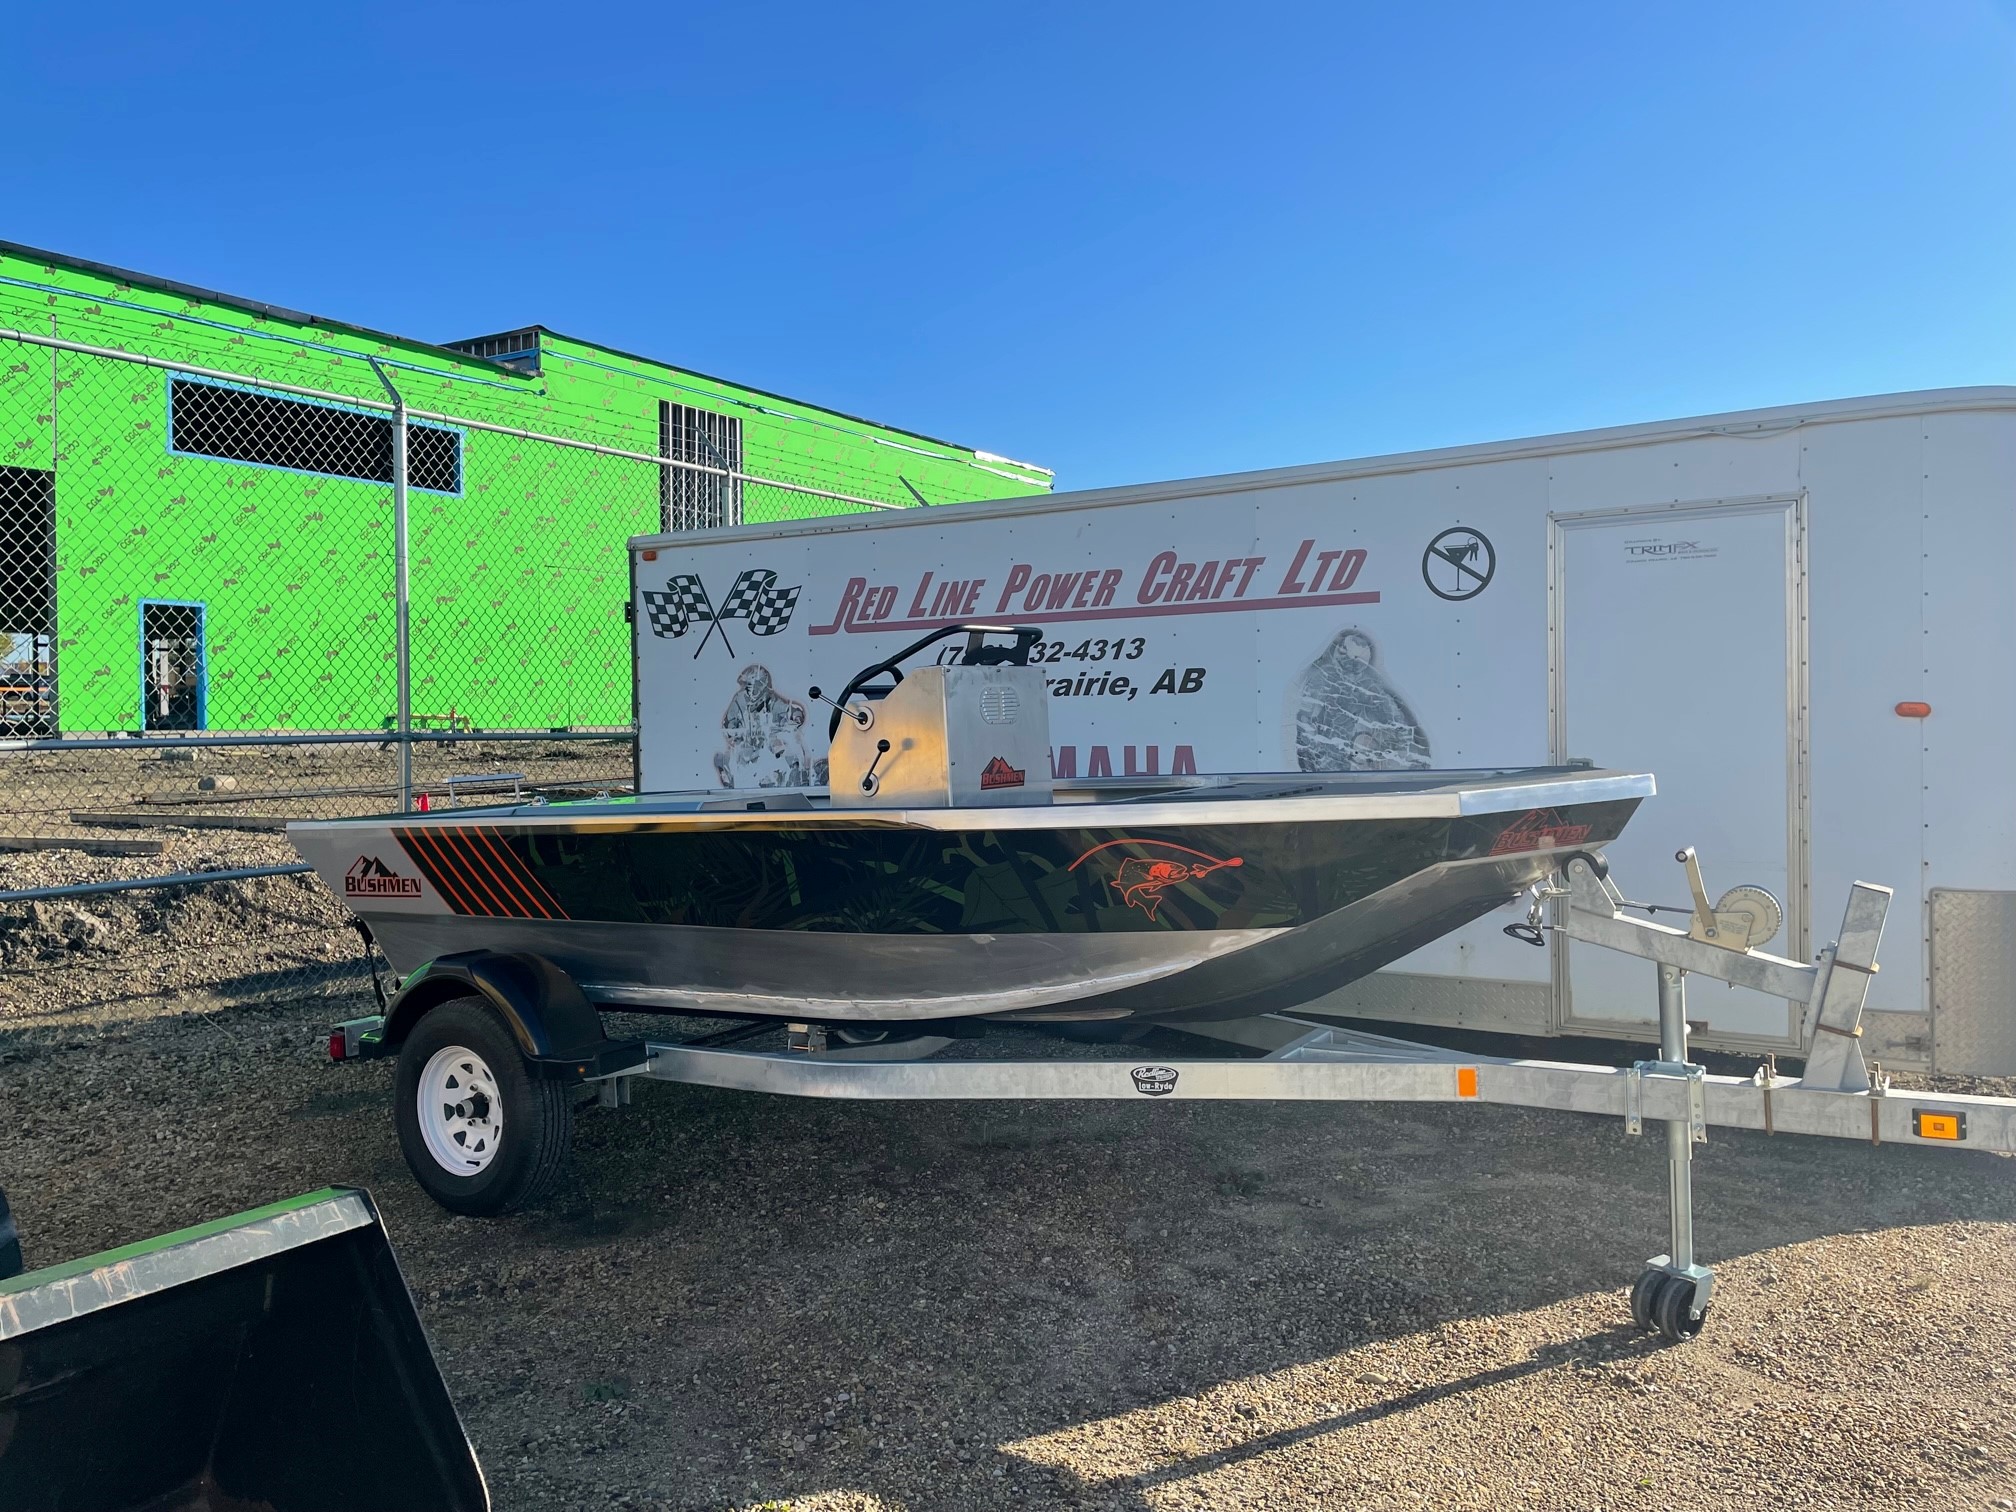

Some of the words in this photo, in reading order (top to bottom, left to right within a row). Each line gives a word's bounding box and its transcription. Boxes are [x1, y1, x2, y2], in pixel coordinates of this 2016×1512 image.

[842, 577, 898, 633] RED
[907, 571, 986, 618] LINE
[995, 564, 1123, 613] POWER
[1136, 550, 1266, 604] CRAFT
[1277, 539, 1367, 594] LTD
[1029, 642, 1146, 663] 32-4313
[1046, 671, 1138, 701] rairie,
[1150, 667, 1207, 695] AB
[983, 770, 1025, 786] BUSHMEN
[345, 876, 422, 893] BUSHMEN
